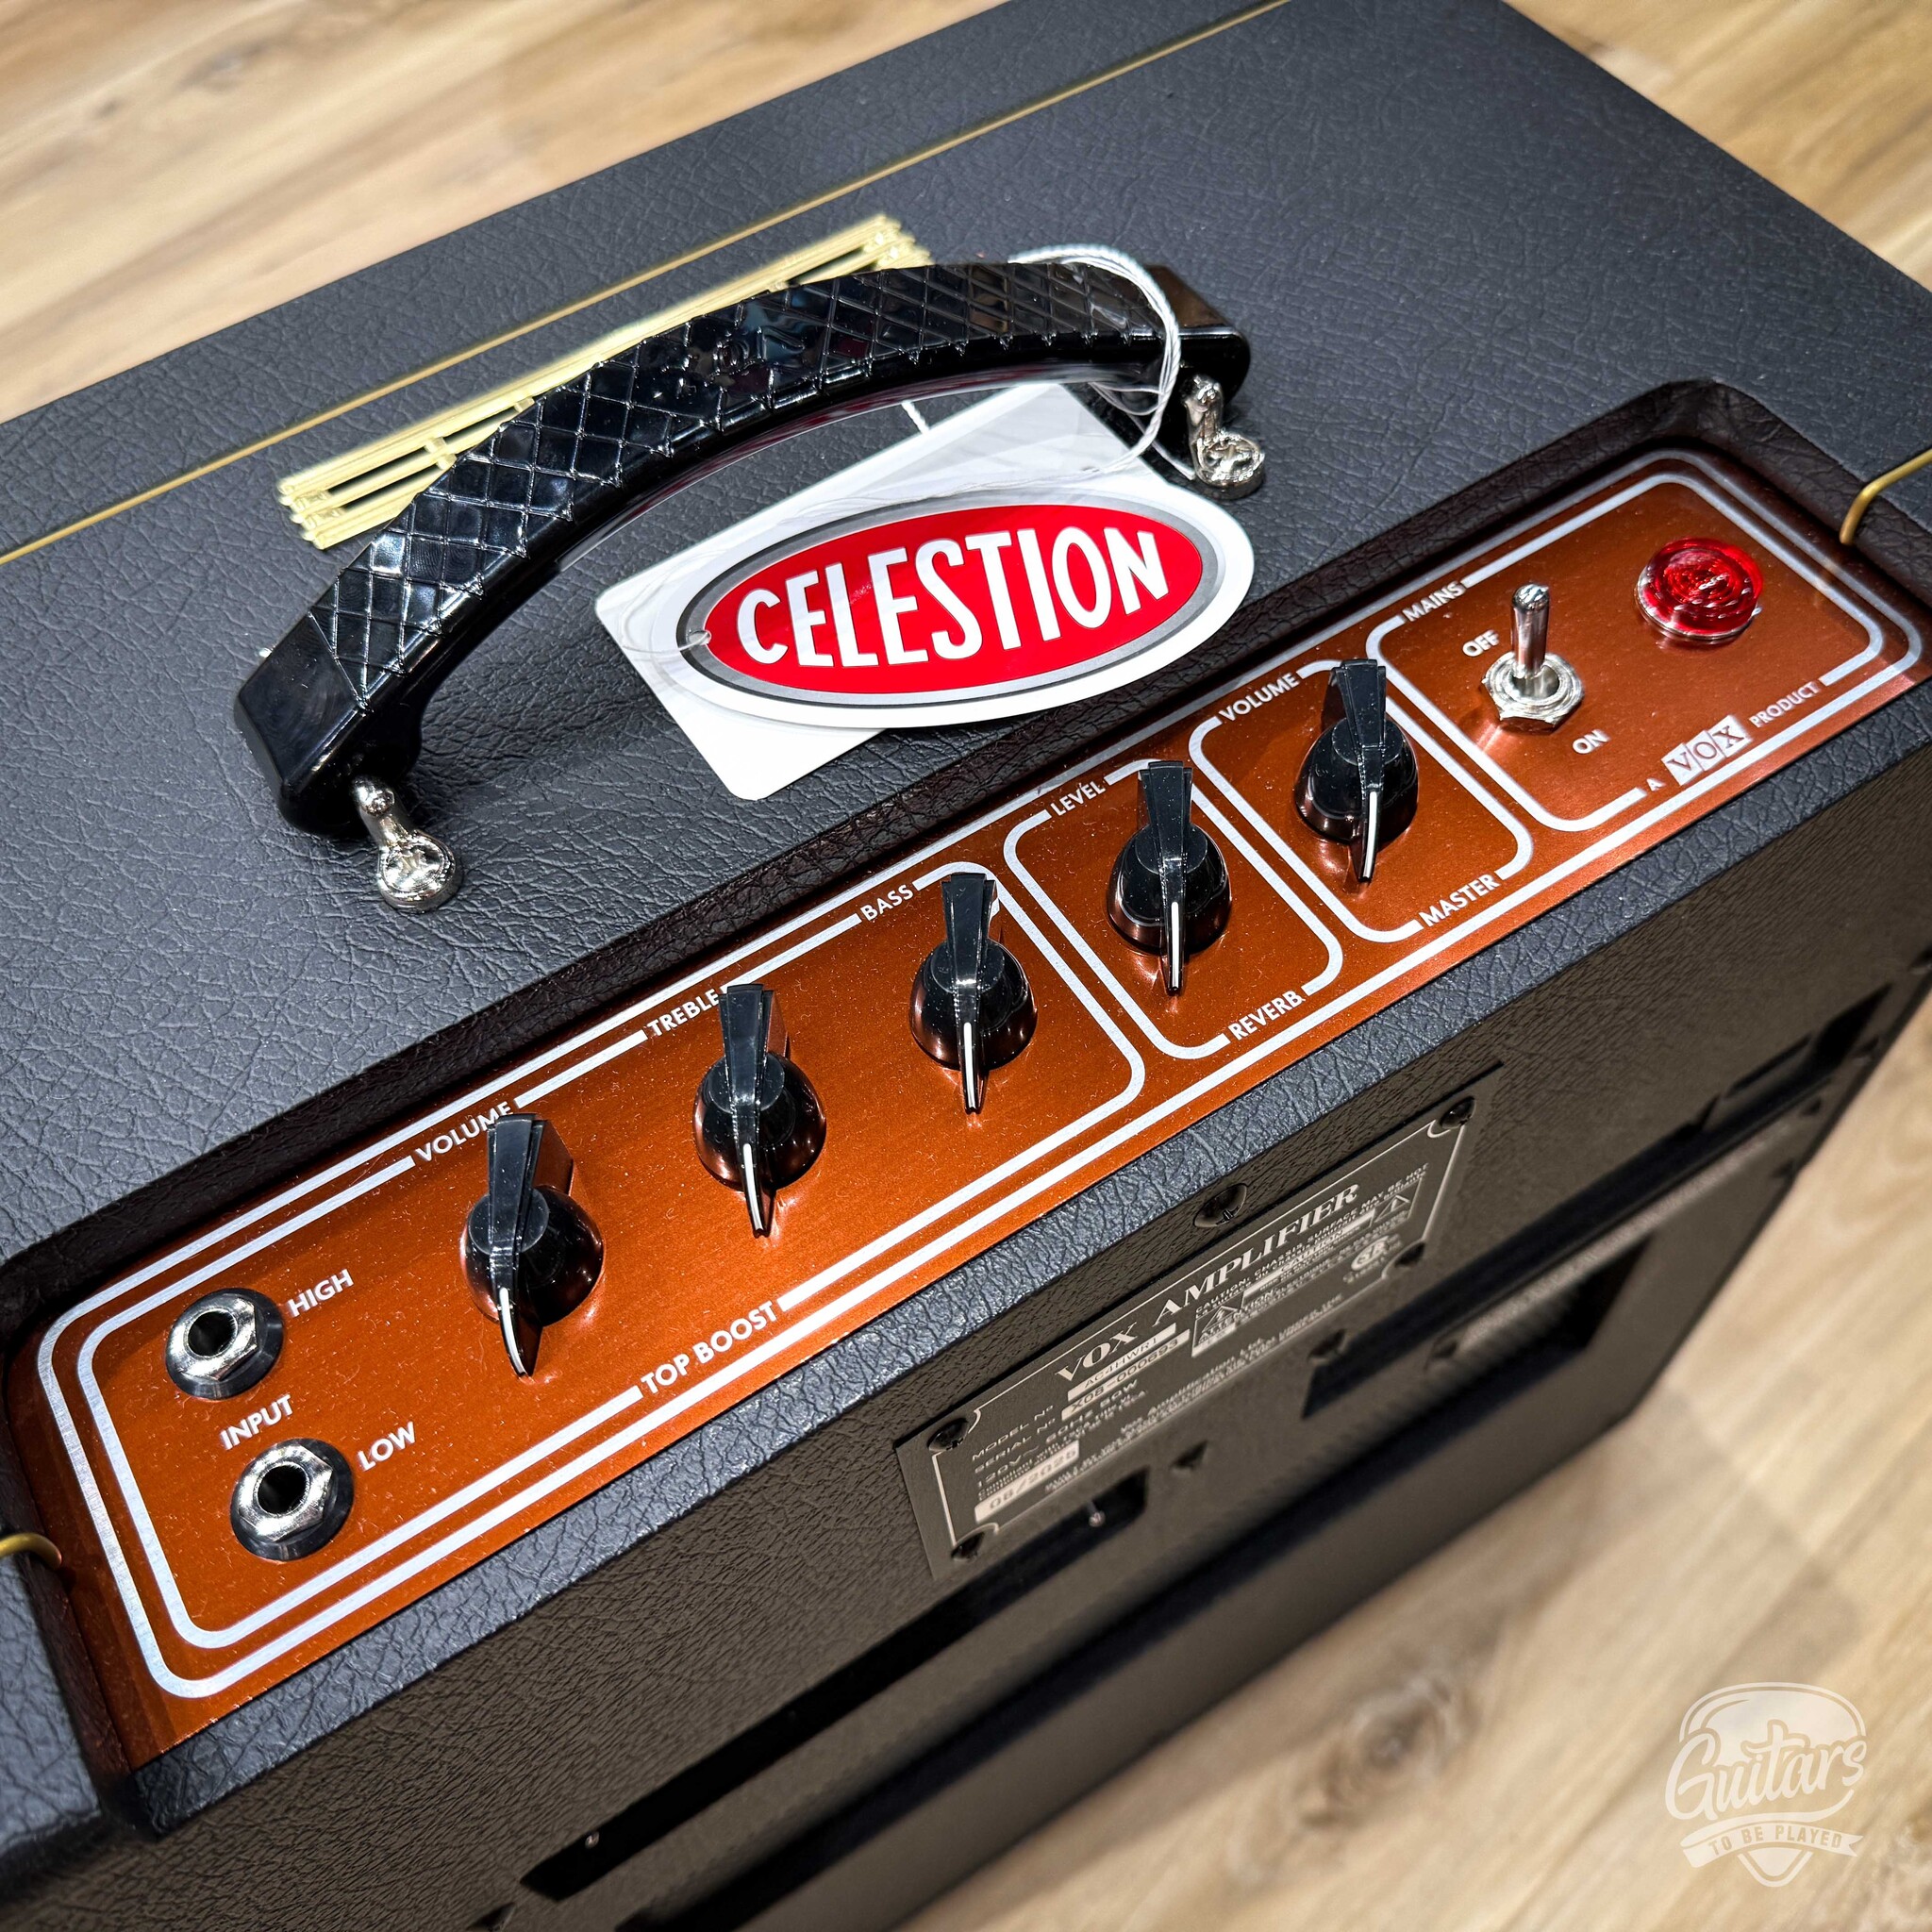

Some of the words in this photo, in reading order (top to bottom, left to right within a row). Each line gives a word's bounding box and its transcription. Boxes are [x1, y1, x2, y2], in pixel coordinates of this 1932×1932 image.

[737, 526, 1171, 668] CELESTION
[1401, 582, 1465, 622] MAINS
[1461, 630, 1500, 658] OFF
[1219, 674, 1299, 724] VOLUME
[1572, 728, 1609, 755] ON
[1645, 777, 1664, 792] A
[1666, 723, 1746, 774] VOX
[1749, 681, 1820, 728] PRODUCT
[1051, 780, 1106, 815] LEVEL
[861, 883, 915, 923] BASS
[1419, 874, 1500, 925] MASTER
[647, 989, 720, 1037] TREBLE
[1228, 989, 1306, 1042] REVERB
[414, 1101, 514, 1162] VOLUME
[1253, 1242, 1303, 1275] CHASSIS
[1306, 1208, 1357, 1242] SURFACE
[1359, 1191, 1384, 1208] MAY
[287, 1269, 354, 1318] HIGH
[1054, 1321, 1138, 1381] VOX
[1152, 1183, 1360, 1327] AMPLIFIER
[641, 1354, 691, 1394] TOP
[691, 1301, 777, 1365] BOOST
[219, 1393, 294, 1450] INPUT
[972, 1422, 1029, 1461] MODEL
[1084, 1337, 1158, 1388] AC4HWR1
[358, 1421, 417, 1472] LOW
[974, 1435, 1032, 1474] SERIAL
[989, 1450, 1076, 1508] 08/2025
